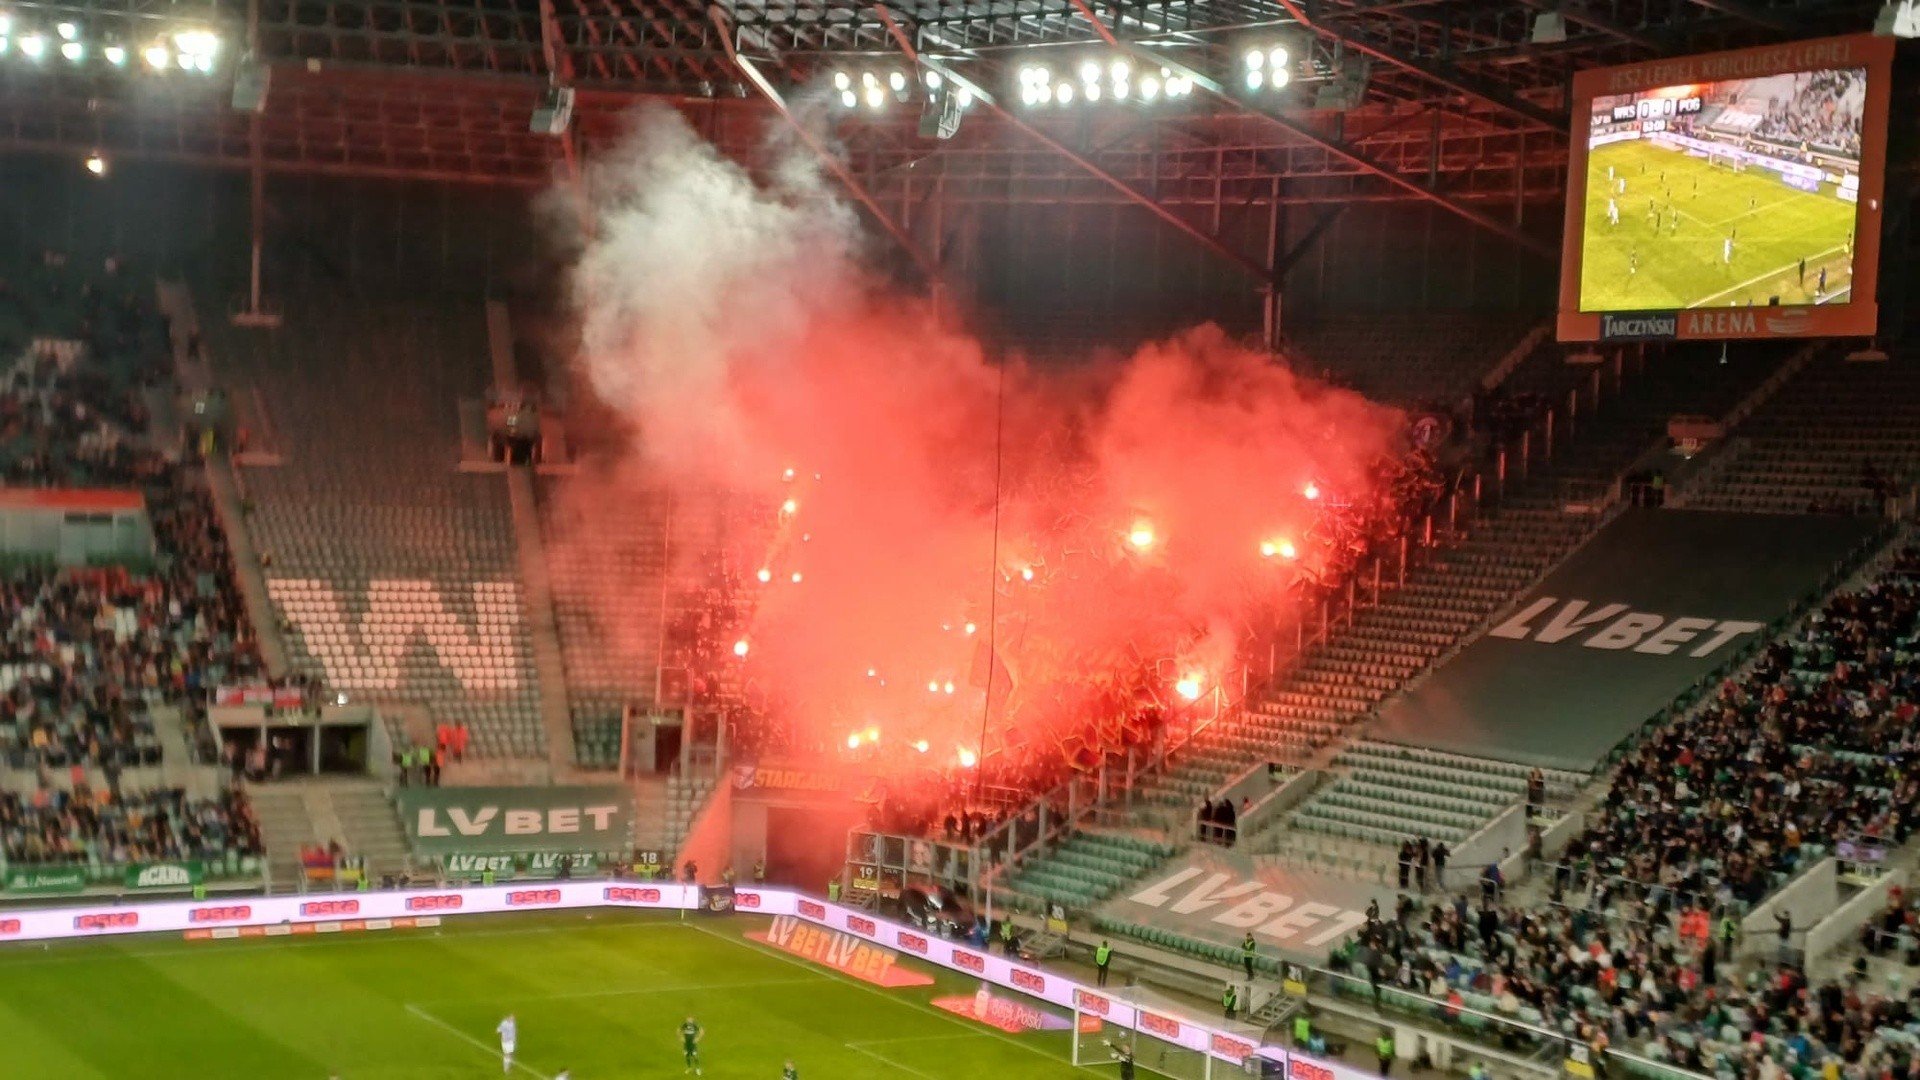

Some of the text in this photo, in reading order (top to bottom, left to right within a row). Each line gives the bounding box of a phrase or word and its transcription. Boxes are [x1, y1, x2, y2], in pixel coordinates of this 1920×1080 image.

[1688, 313, 1756, 334] ARENA
[640, 852, 658, 865] 18
[860, 866, 873, 879] 19
